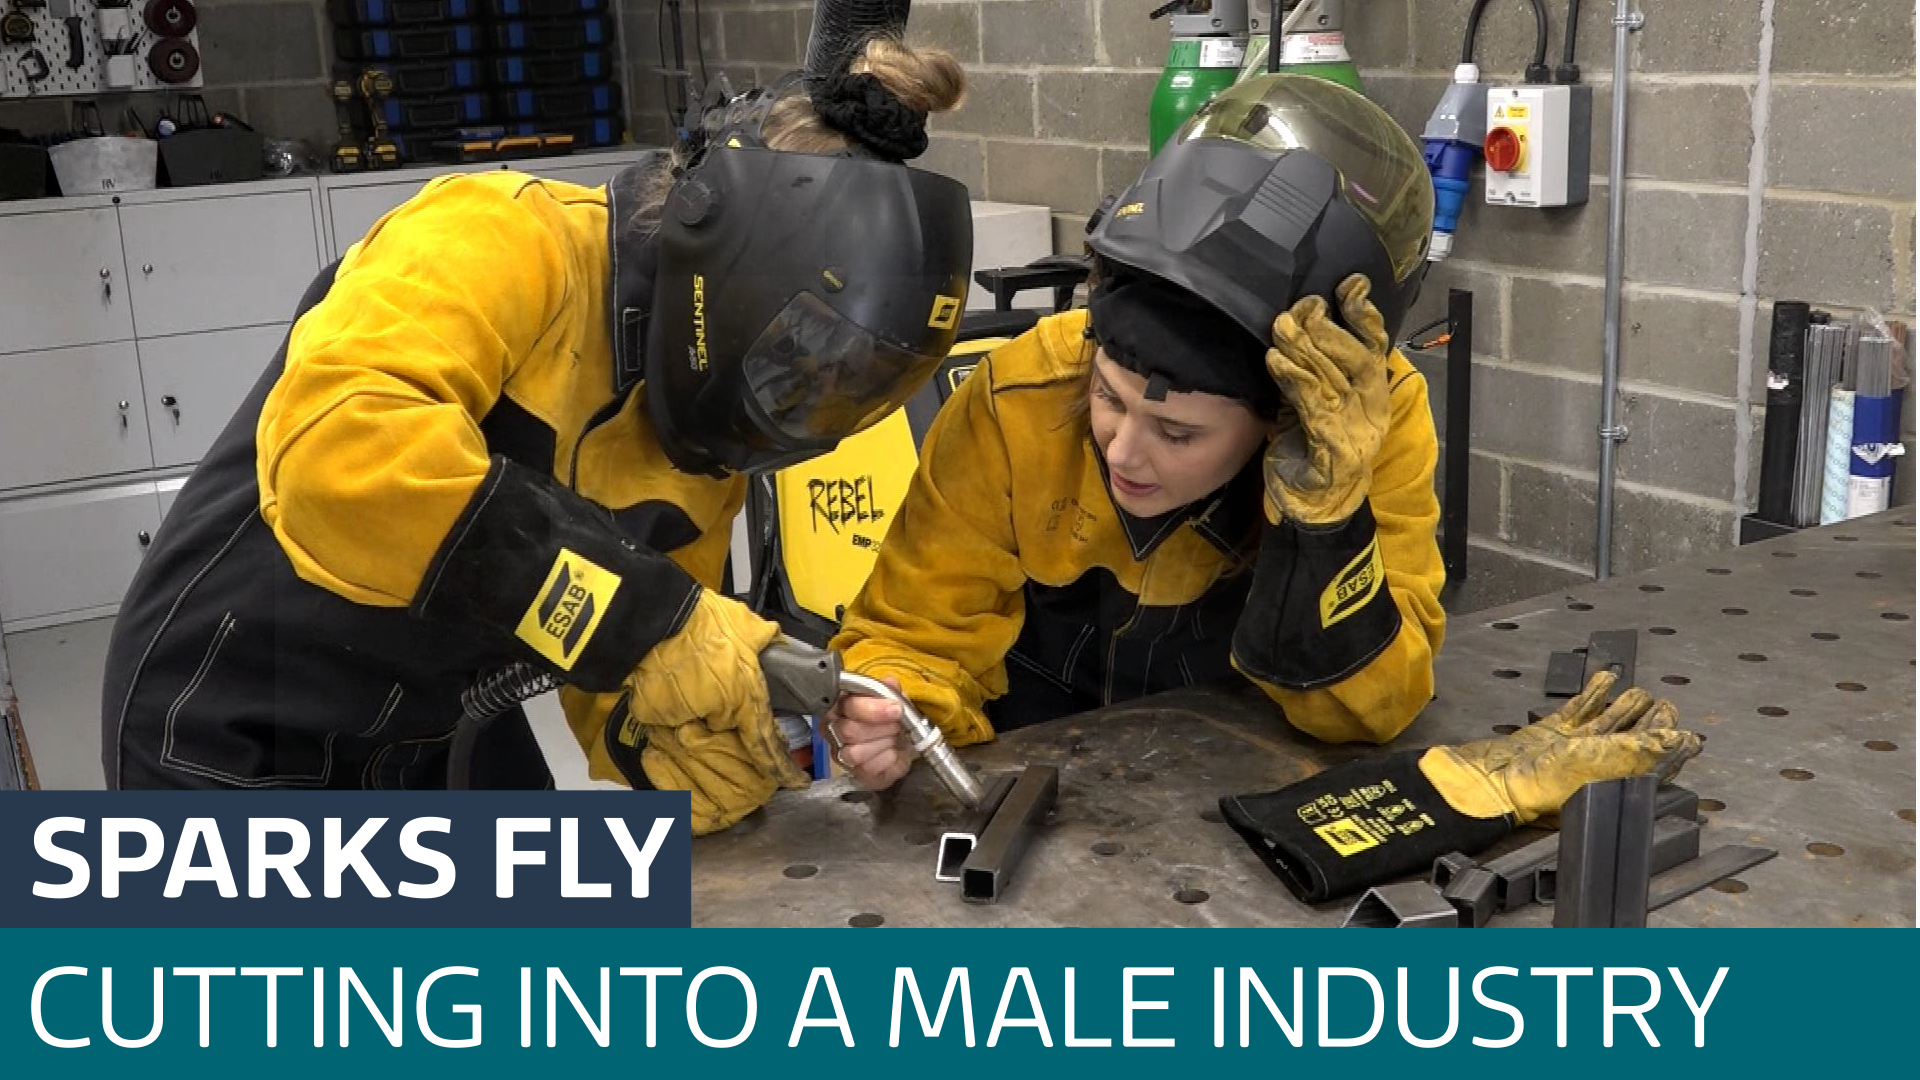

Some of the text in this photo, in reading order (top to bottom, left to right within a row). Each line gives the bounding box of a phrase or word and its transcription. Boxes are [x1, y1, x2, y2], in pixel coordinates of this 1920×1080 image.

[693, 274, 709, 372] SENTINEL
[806, 475, 885, 535] REBEL
[1336, 562, 1376, 601] ESAB
[545, 584, 587, 640] ESAB
